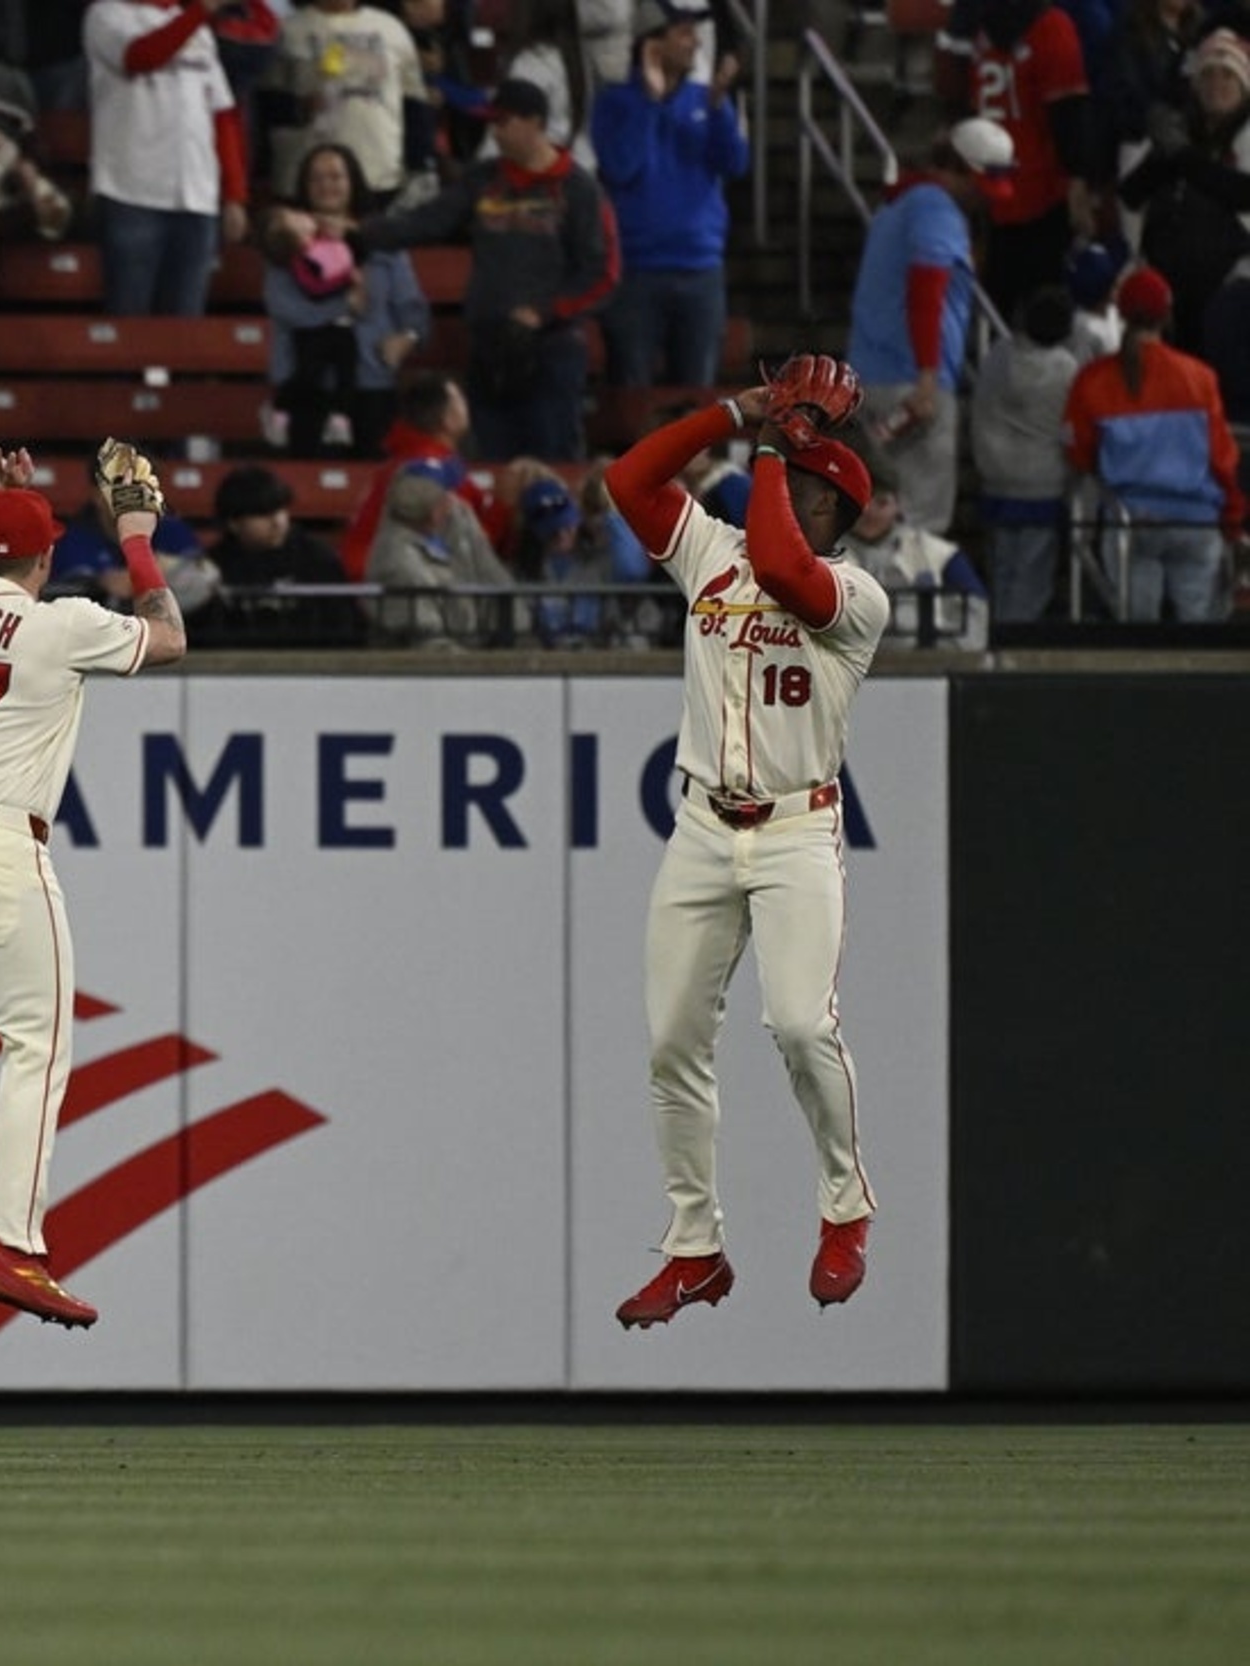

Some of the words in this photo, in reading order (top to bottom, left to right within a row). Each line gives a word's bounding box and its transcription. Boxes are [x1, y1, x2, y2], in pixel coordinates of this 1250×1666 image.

[978, 61, 1020, 120] 21
[729, 610, 802, 656] Louis
[762, 663, 812, 708] 18
